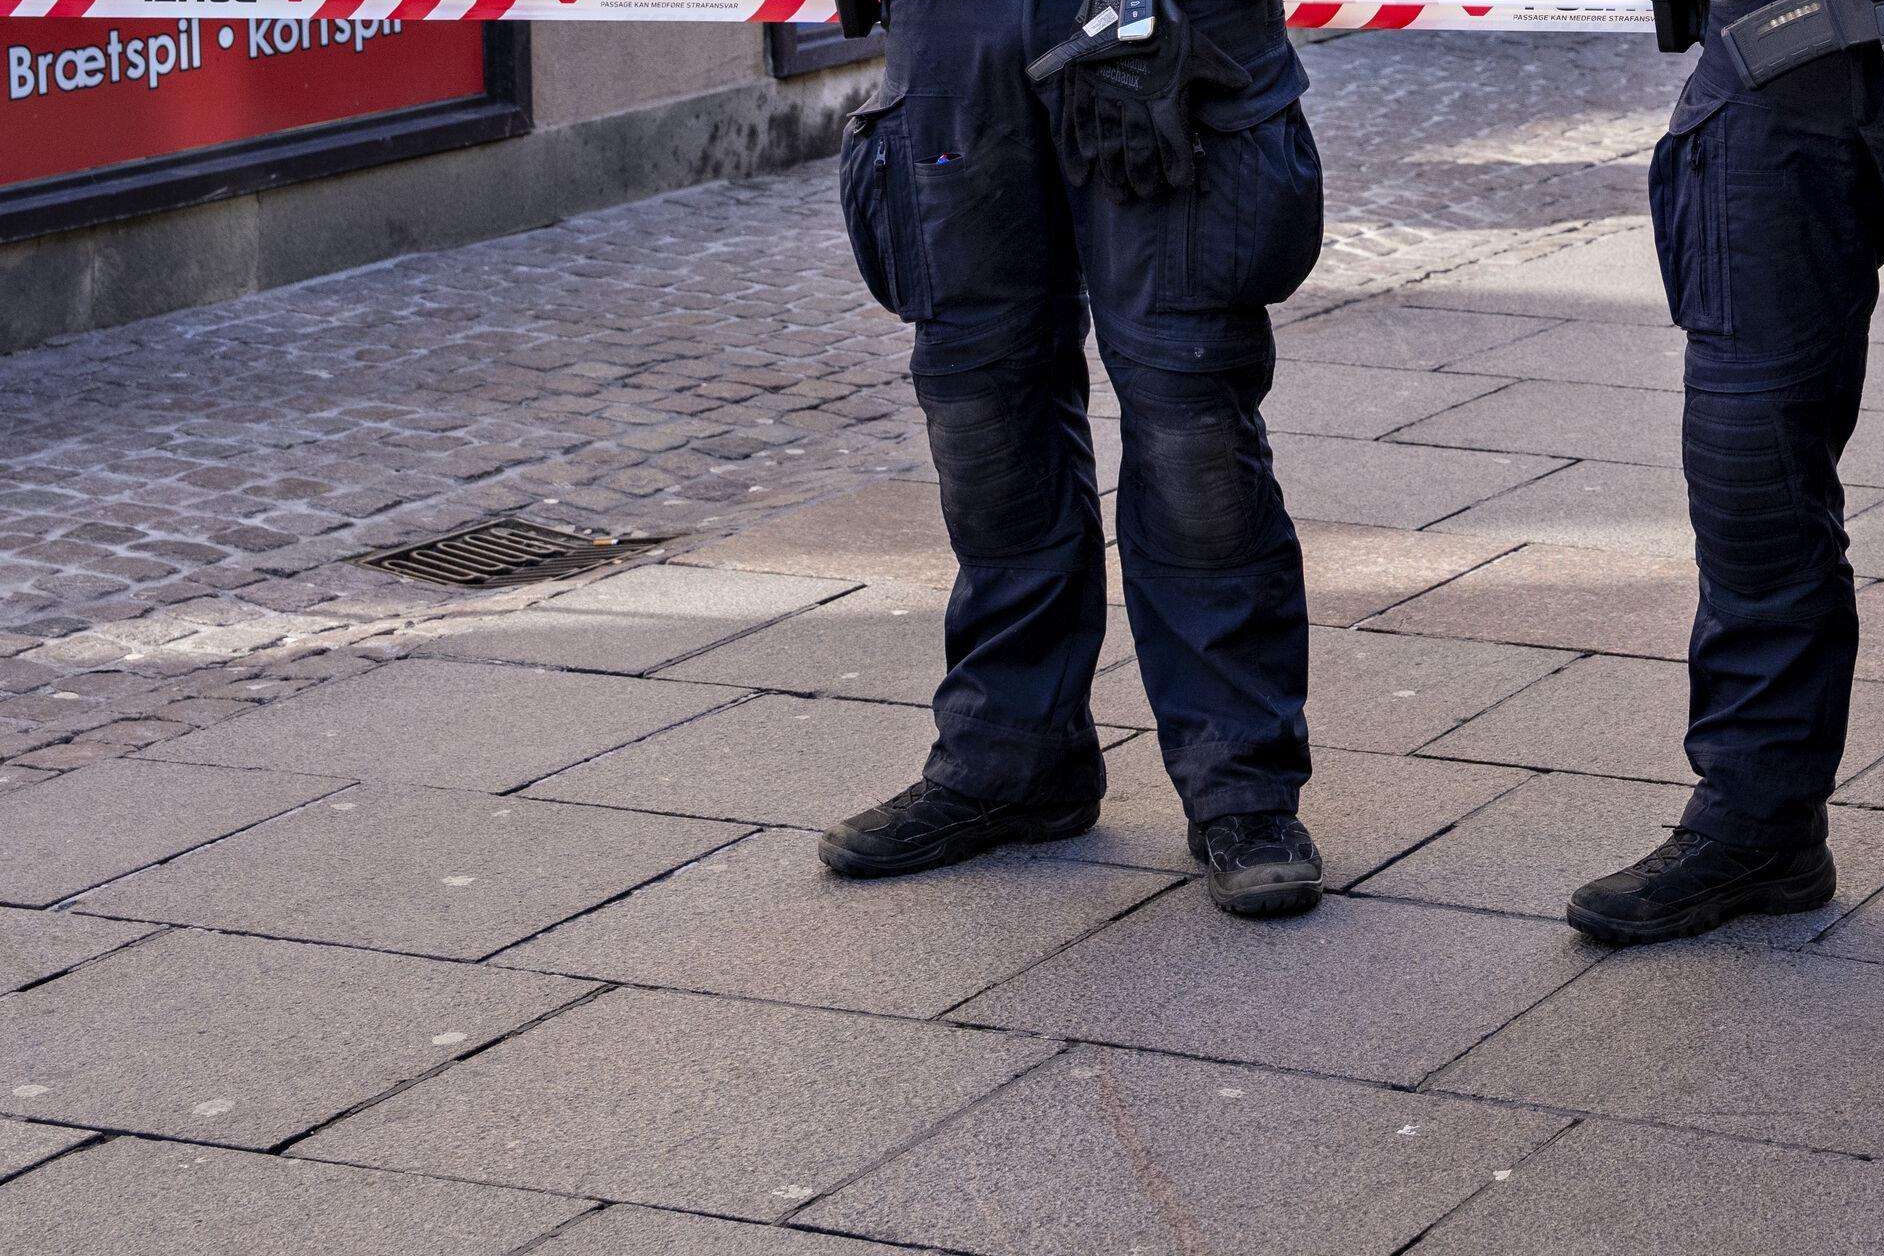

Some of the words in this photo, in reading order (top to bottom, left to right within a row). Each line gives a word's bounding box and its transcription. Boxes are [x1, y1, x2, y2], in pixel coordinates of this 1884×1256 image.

[651, 1, 685, 9] MEDFØRE
[1569, 14, 1607, 22] MEDFØRE
[1608, 15, 1656, 23] STRAFANSV
[8, 17, 202, 101] Brætspil
